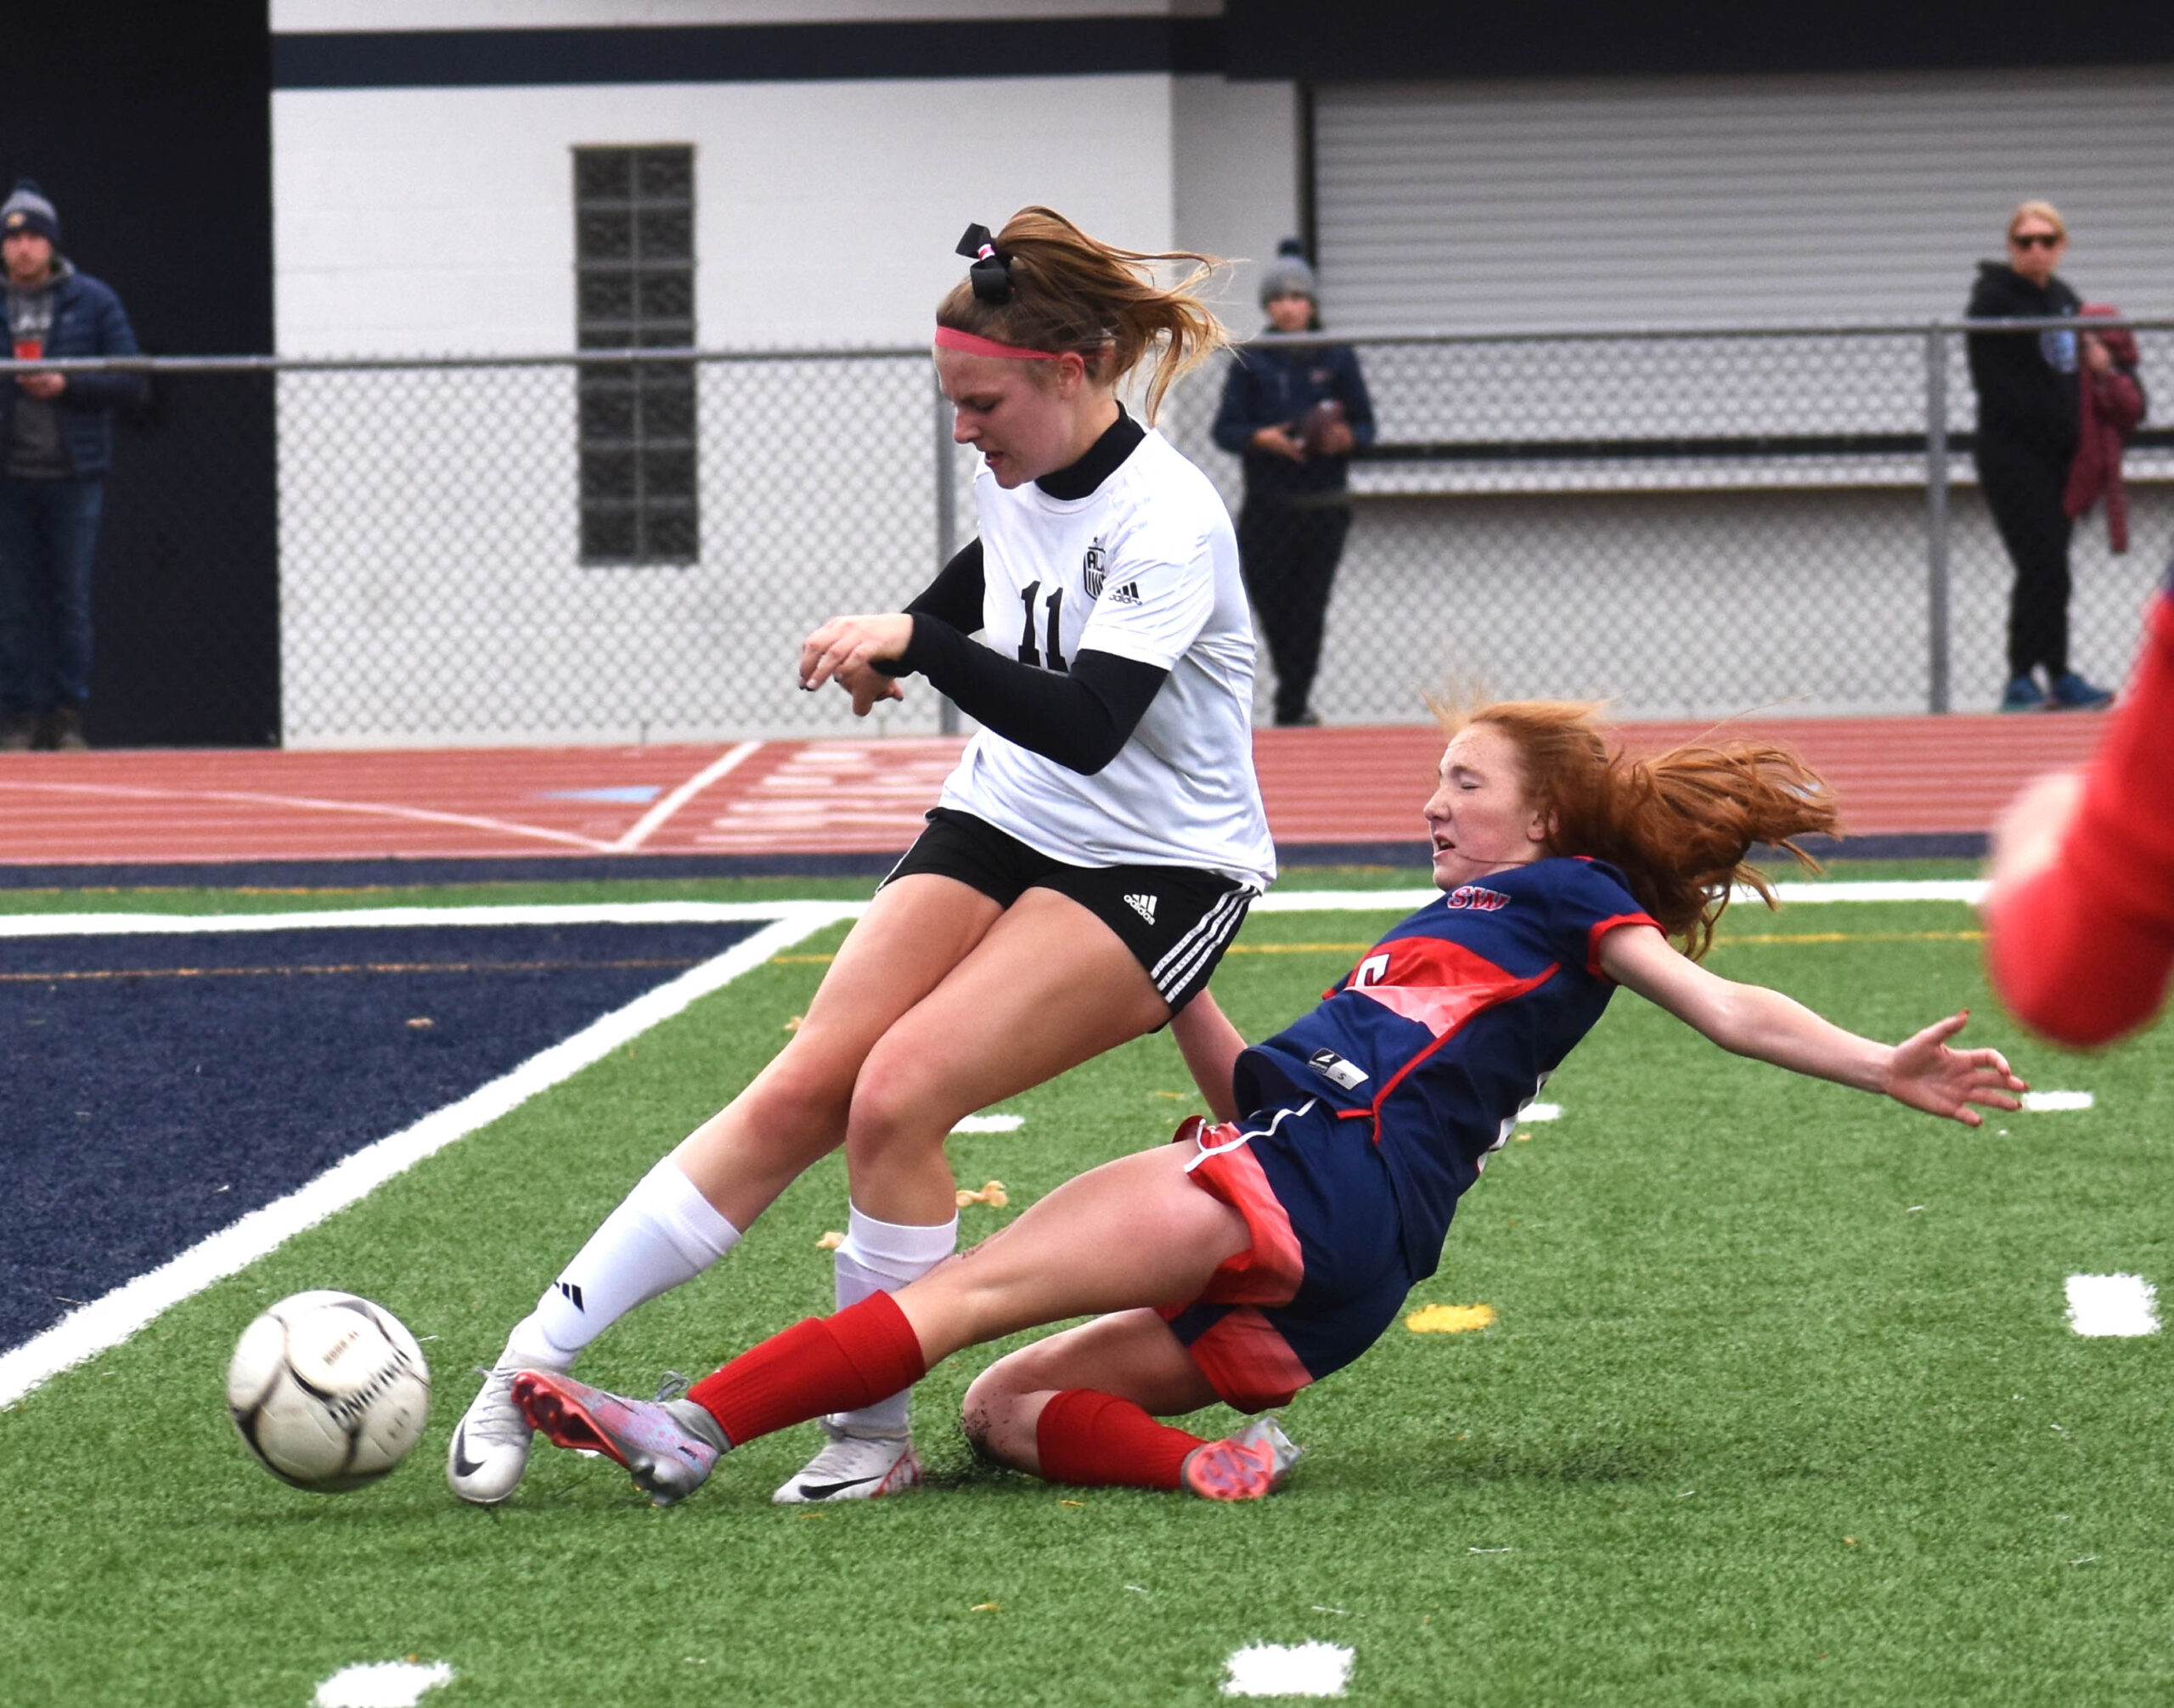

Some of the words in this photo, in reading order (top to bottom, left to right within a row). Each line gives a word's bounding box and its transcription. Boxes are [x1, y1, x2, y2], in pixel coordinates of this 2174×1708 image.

[1018, 580, 1069, 673] 11
[1123, 894, 1156, 926] adidas
[1447, 886, 1511, 911] SW
